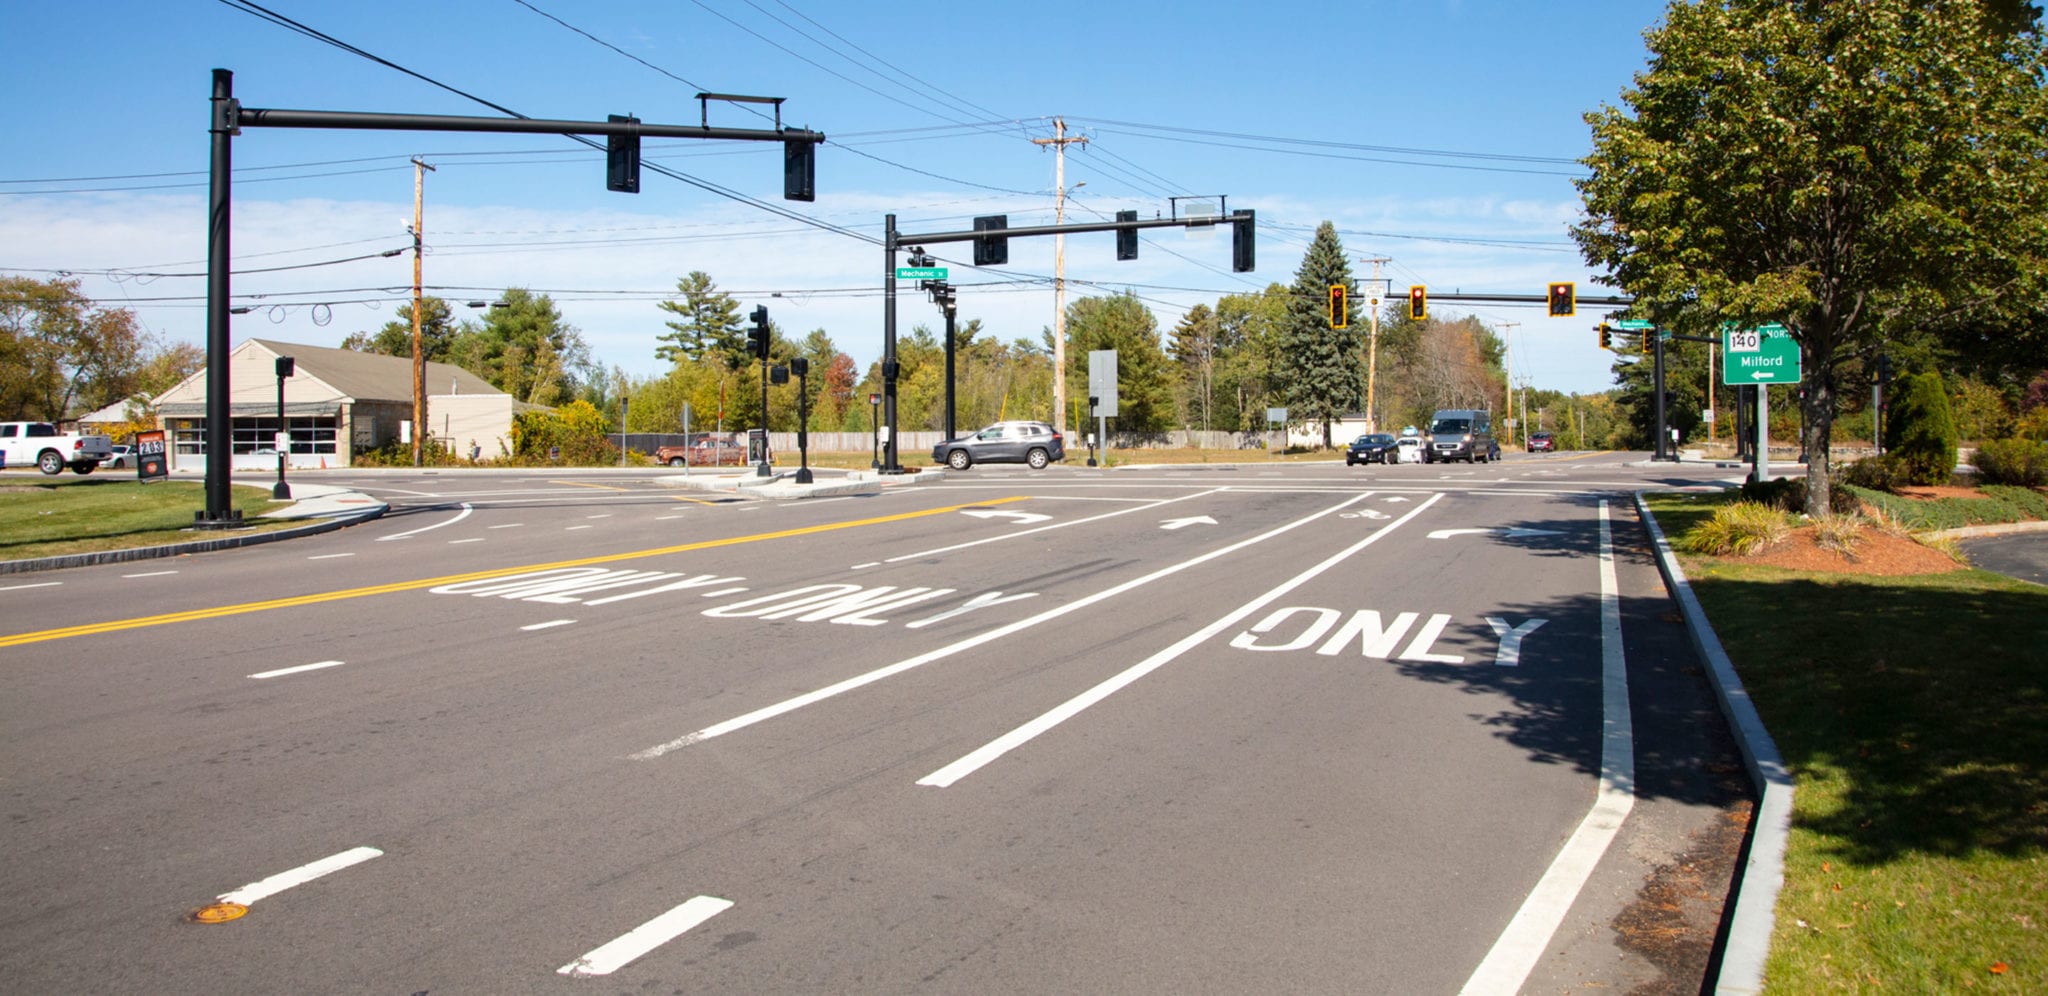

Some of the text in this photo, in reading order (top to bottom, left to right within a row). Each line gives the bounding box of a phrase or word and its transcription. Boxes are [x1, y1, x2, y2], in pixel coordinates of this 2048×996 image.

[1732, 336, 1757, 347] 140
[1741, 355, 1783, 367] Milford
[429, 567, 748, 606] ONLY
[701, 584, 1040, 628] ONLY
[1229, 606, 1549, 667] ONLY
